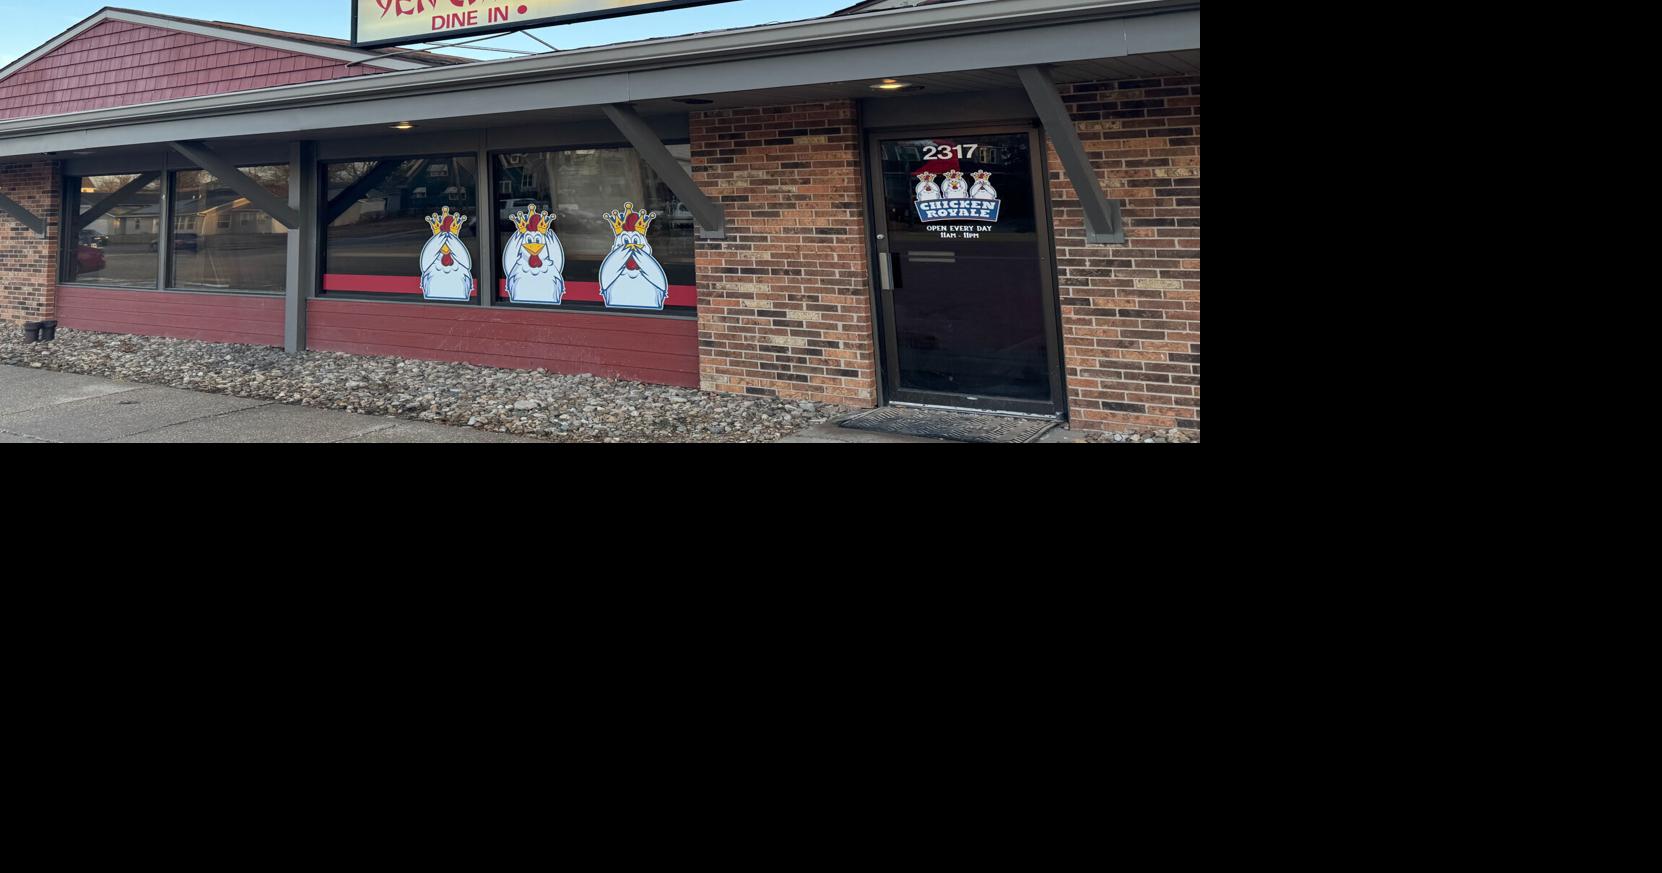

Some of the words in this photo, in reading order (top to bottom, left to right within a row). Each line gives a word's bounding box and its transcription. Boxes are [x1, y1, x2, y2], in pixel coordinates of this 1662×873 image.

[431, 10, 478, 31] DINE
[487, 5, 509, 23] IN
[922, 143, 978, 160] 2317
[920, 200, 996, 210] CHICKEN
[925, 208, 990, 218] ROYALE
